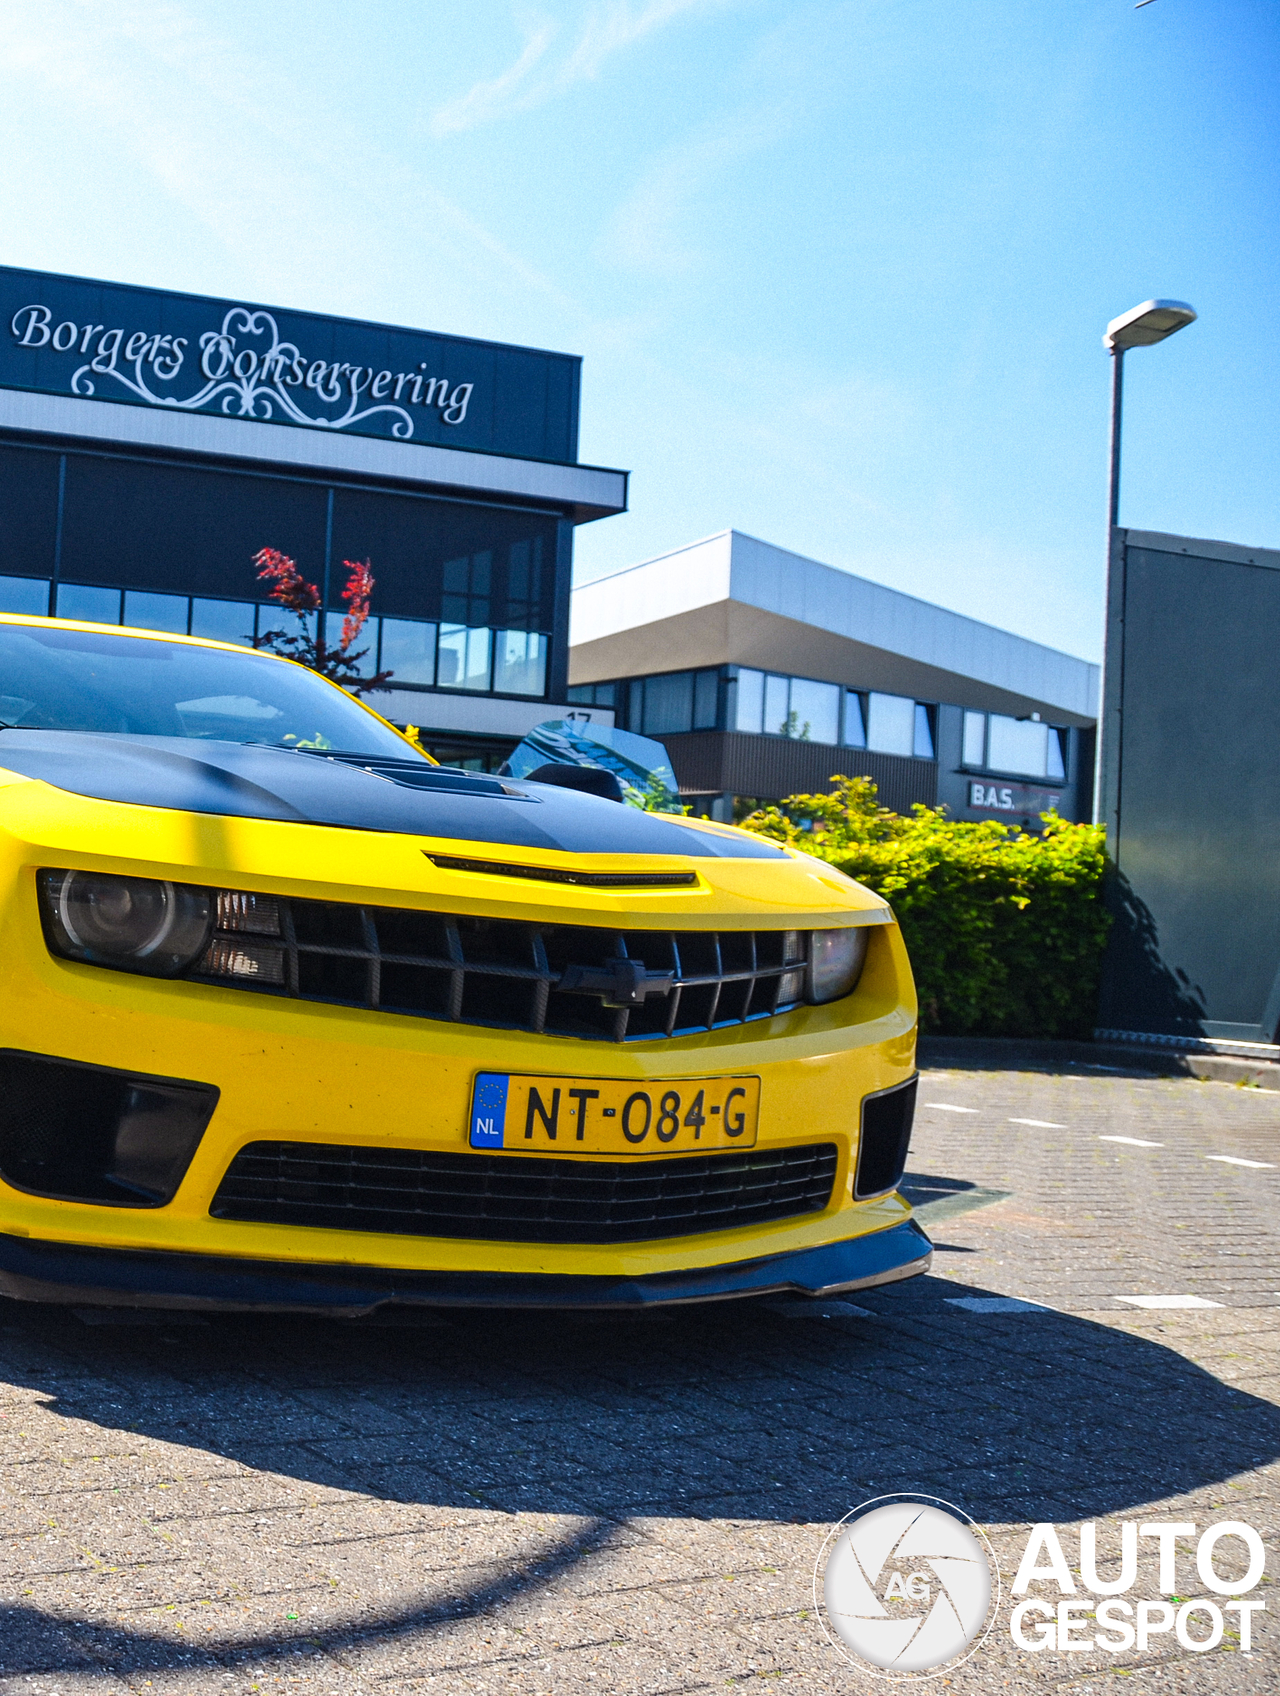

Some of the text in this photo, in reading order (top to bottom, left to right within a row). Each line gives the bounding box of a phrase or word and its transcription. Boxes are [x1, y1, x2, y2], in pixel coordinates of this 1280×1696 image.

[11, 304, 475, 425] Borgers Conservering
[971, 783, 1015, 810] B.A.S.
[475, 1117, 499, 1135] NL
[523, 1086, 747, 1144] NT-084-G
